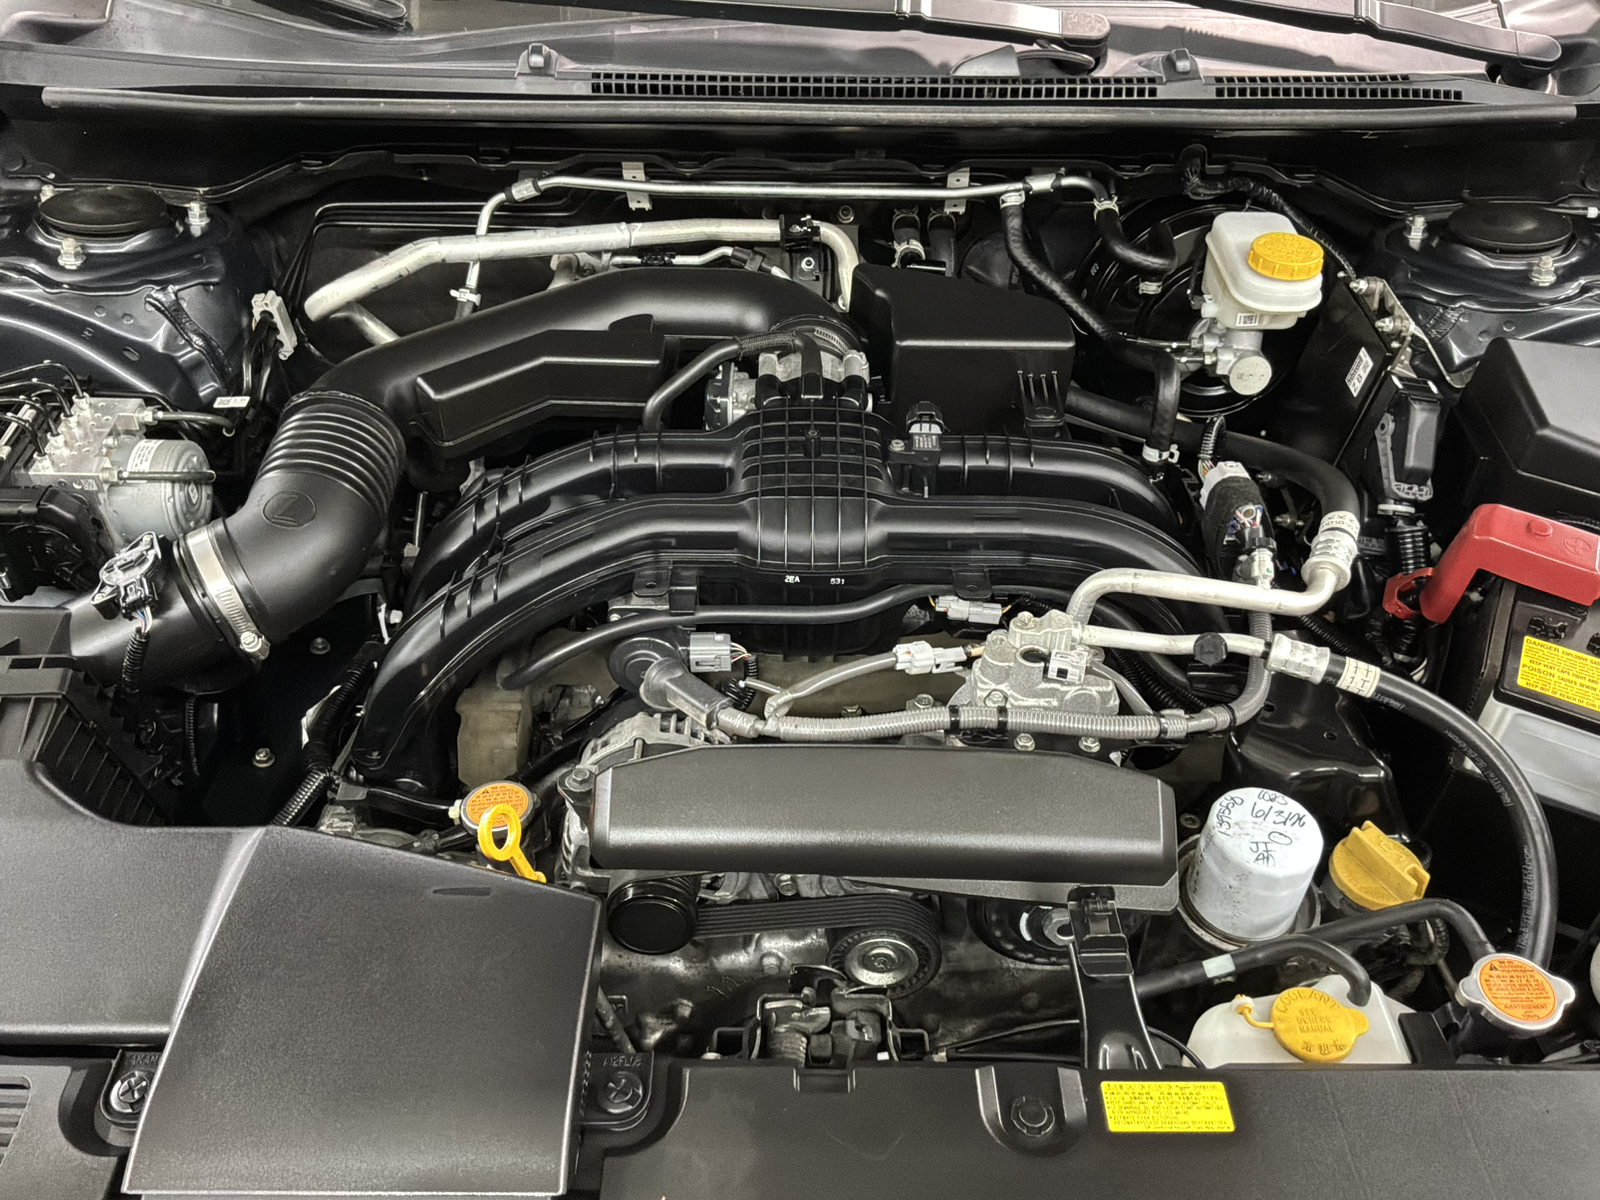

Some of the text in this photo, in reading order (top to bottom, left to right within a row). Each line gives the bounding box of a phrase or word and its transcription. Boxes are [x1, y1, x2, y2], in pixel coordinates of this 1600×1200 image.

[1526, 639, 1560, 653] DANGER
[1562, 651, 1588, 662] EXPLOSIVE
[1522, 663, 1598, 693] POISON CAUSES SEVERE
[1543, 663, 1556, 671] VENT
[1557, 667, 1571, 676] CAPS
[1572, 672, 1587, 681] TIGHT
[1525, 681, 1539, 689] KEEP
[1559, 692, 1577, 702] REACH
[1577, 696, 1585, 704] OF
[1275, 988, 1341, 1013] COOLANT
